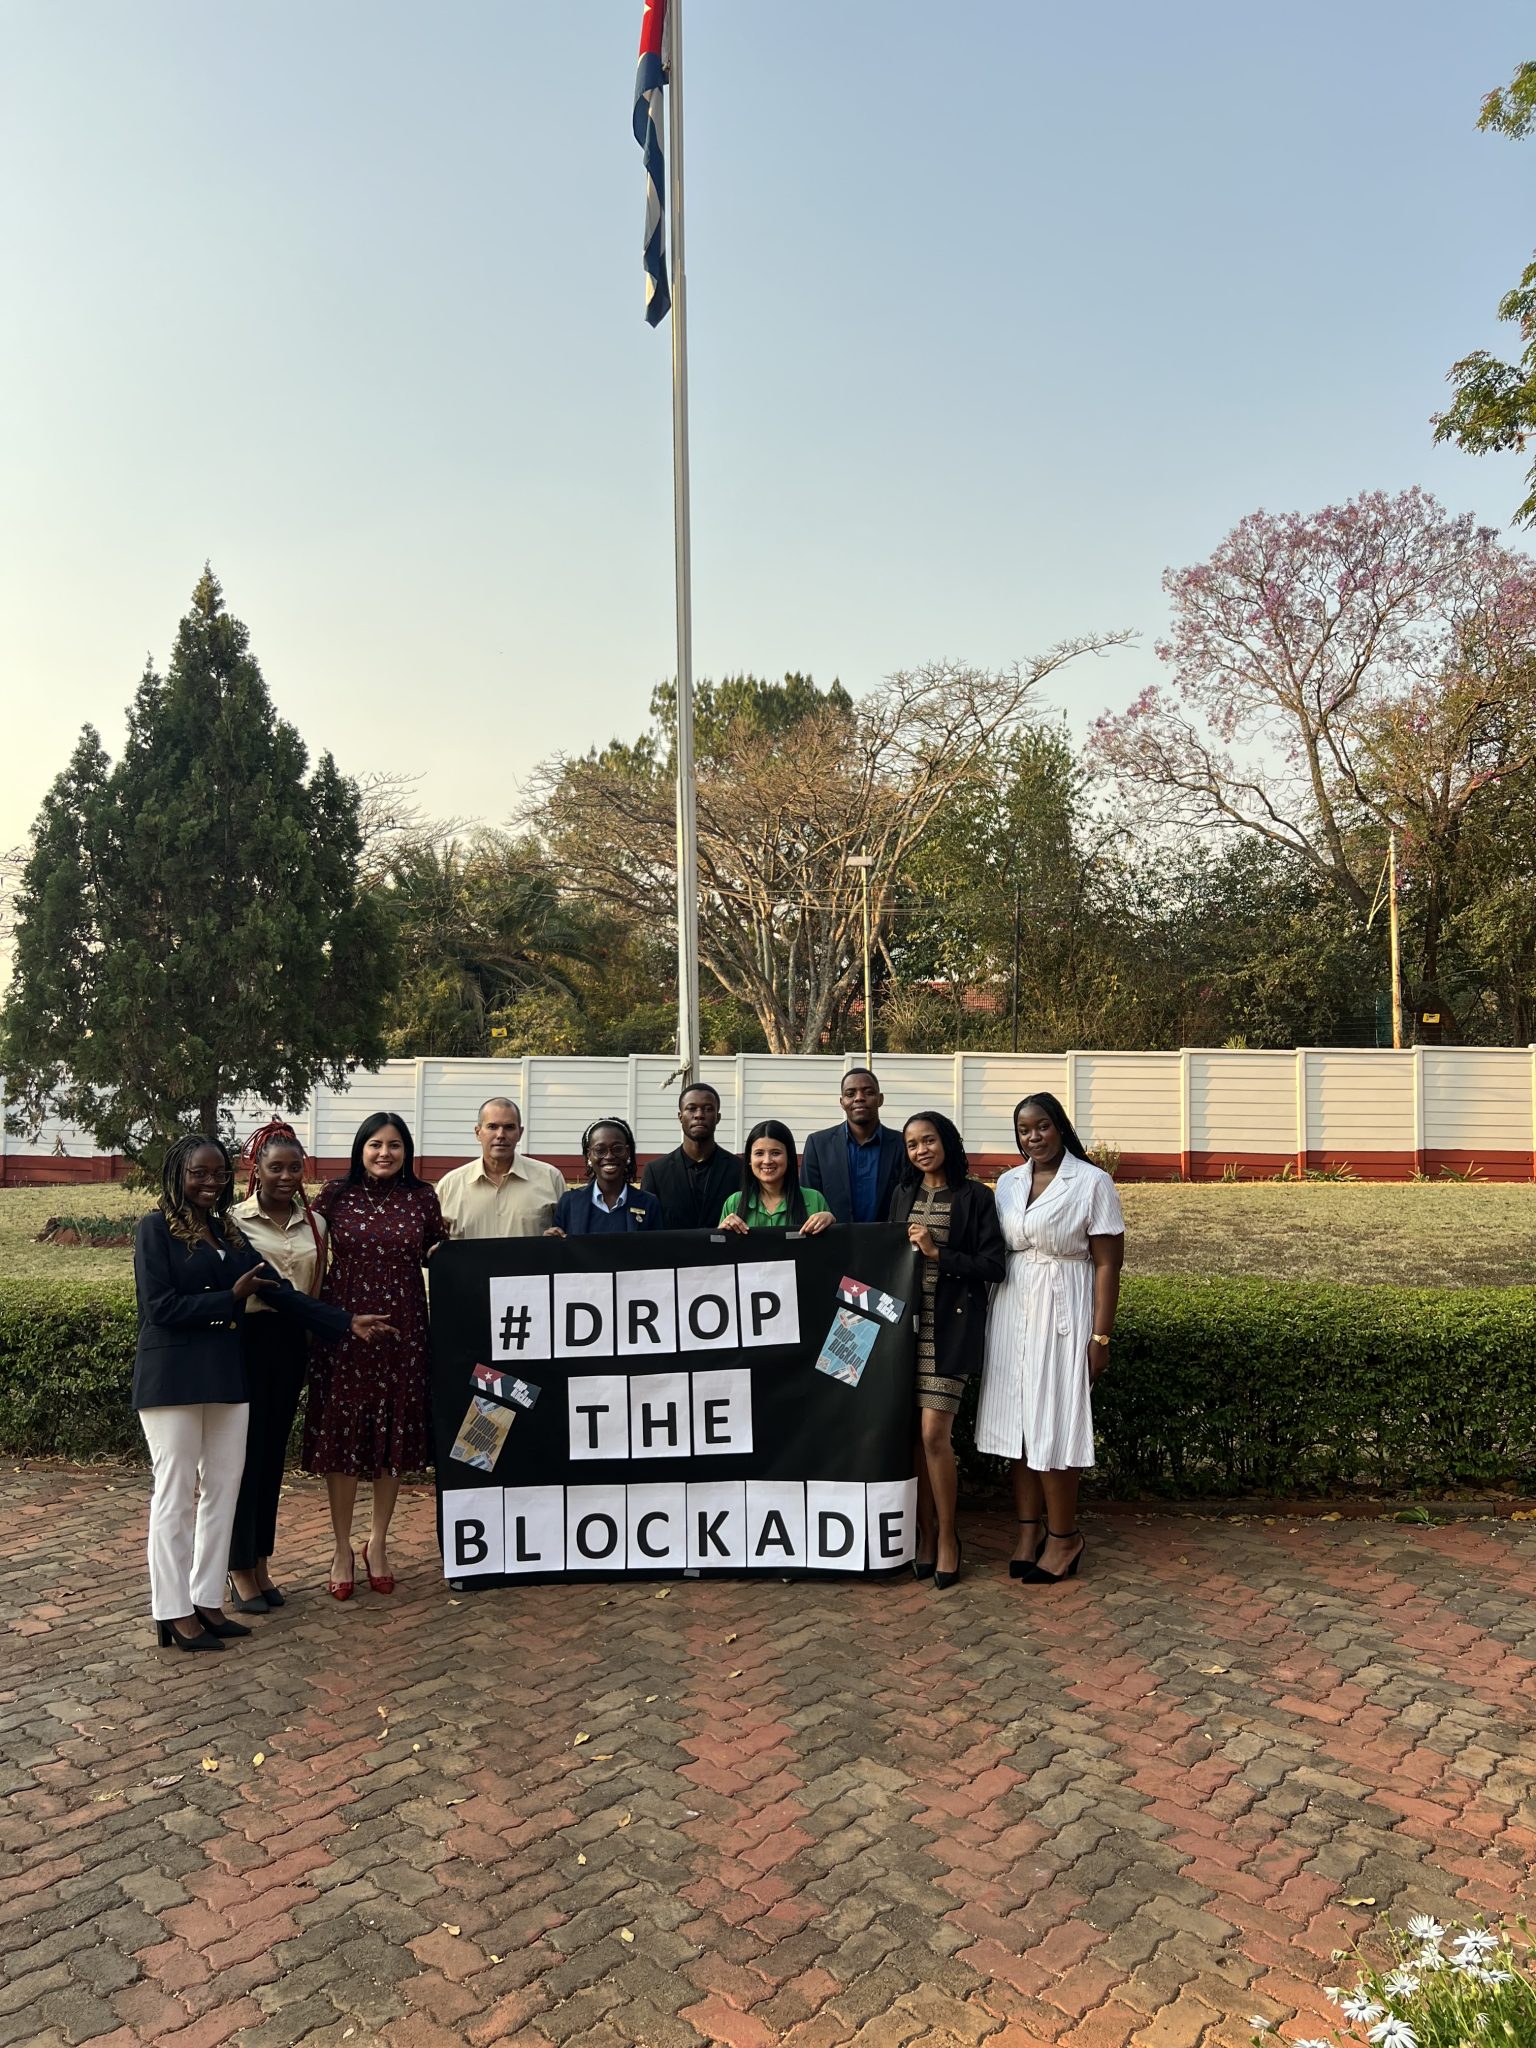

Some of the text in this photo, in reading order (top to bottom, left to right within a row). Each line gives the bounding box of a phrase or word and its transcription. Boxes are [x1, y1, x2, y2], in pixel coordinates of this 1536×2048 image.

[499, 1291, 781, 1350] #DROP
[575, 1398, 732, 1449] THE
[454, 1510, 905, 1566] BLOCKADE
